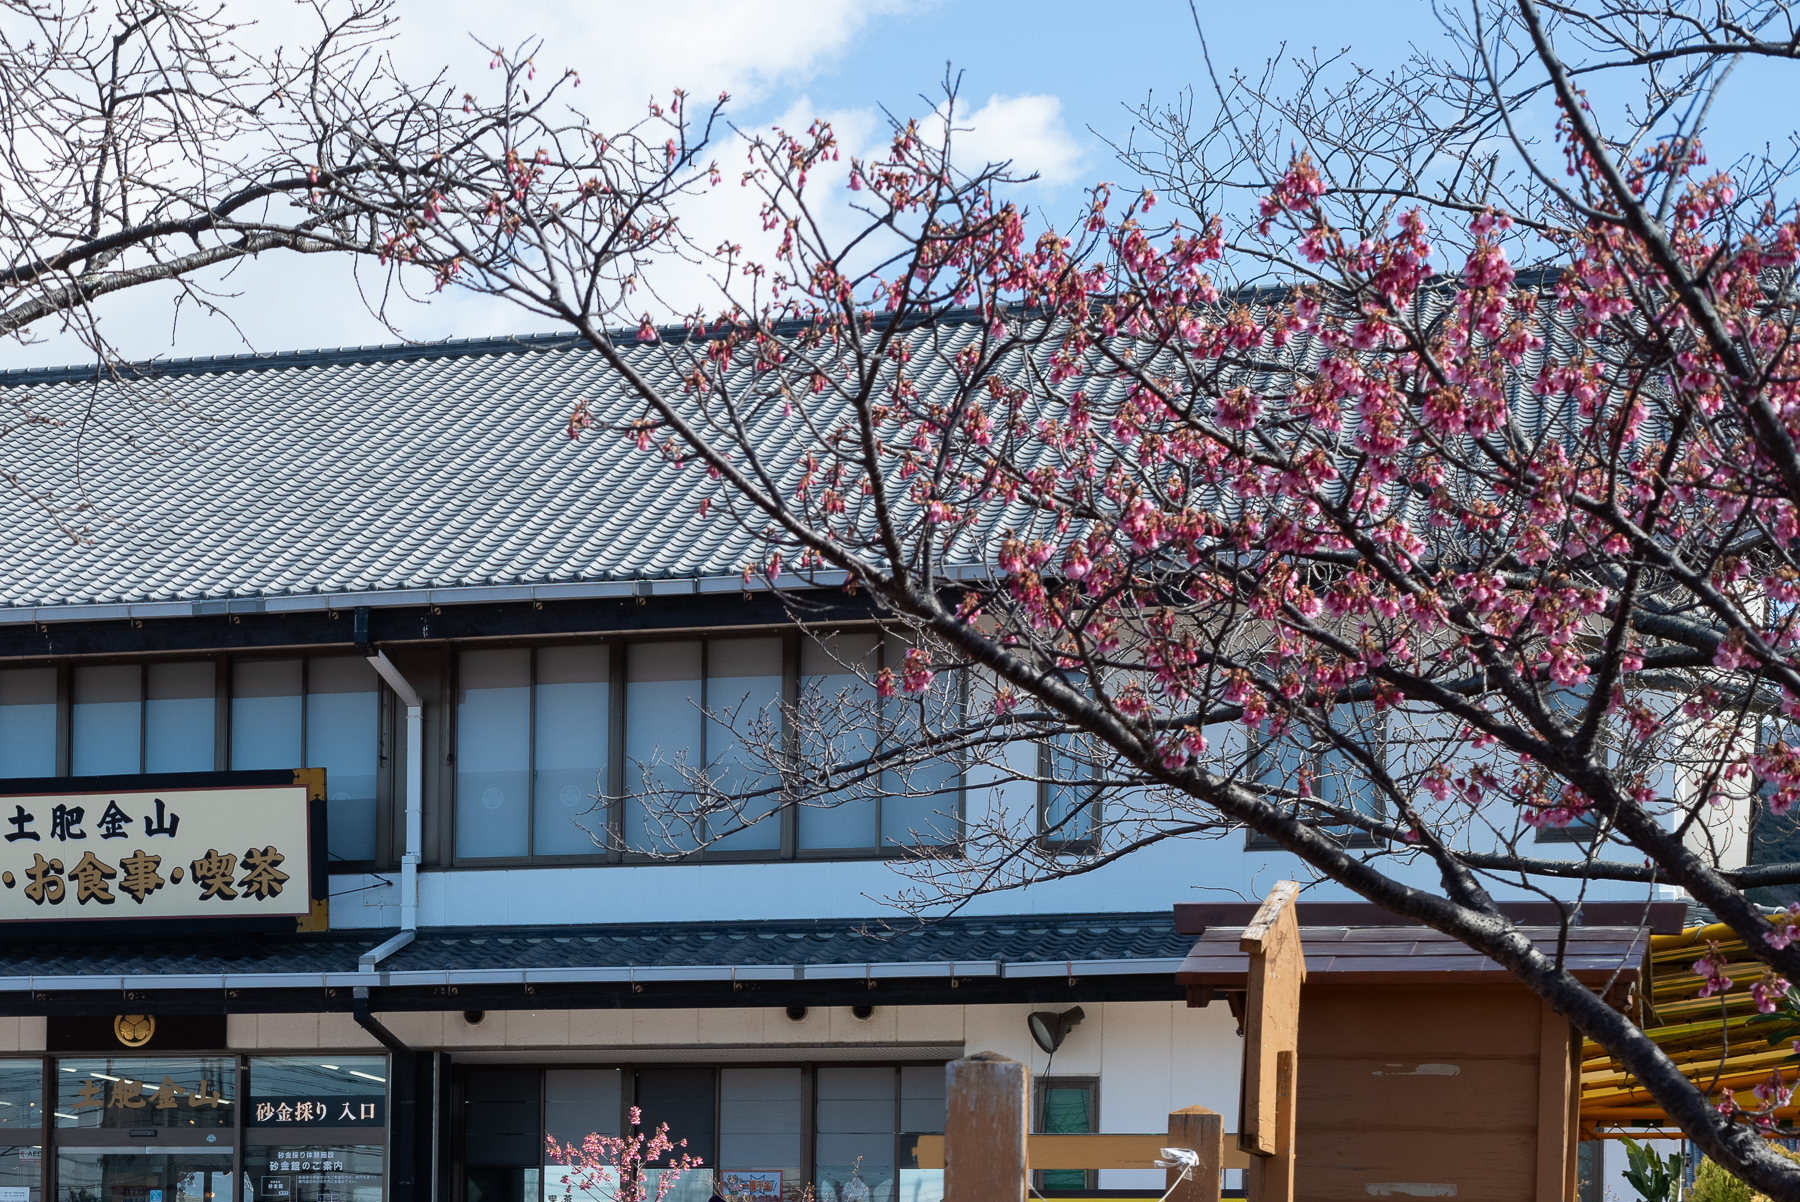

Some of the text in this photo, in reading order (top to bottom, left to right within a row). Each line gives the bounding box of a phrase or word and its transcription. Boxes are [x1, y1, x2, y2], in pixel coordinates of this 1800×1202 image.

[4, 798, 181, 843] 土肥金山
[72, 1076, 220, 1110] 土肥金山
[255, 1101, 376, 1123] 砂金採り 入口
[269, 1161, 343, 1171] 砂金館のご案内
[277, 1151, 335, 1159] 砂金採り体験施設
